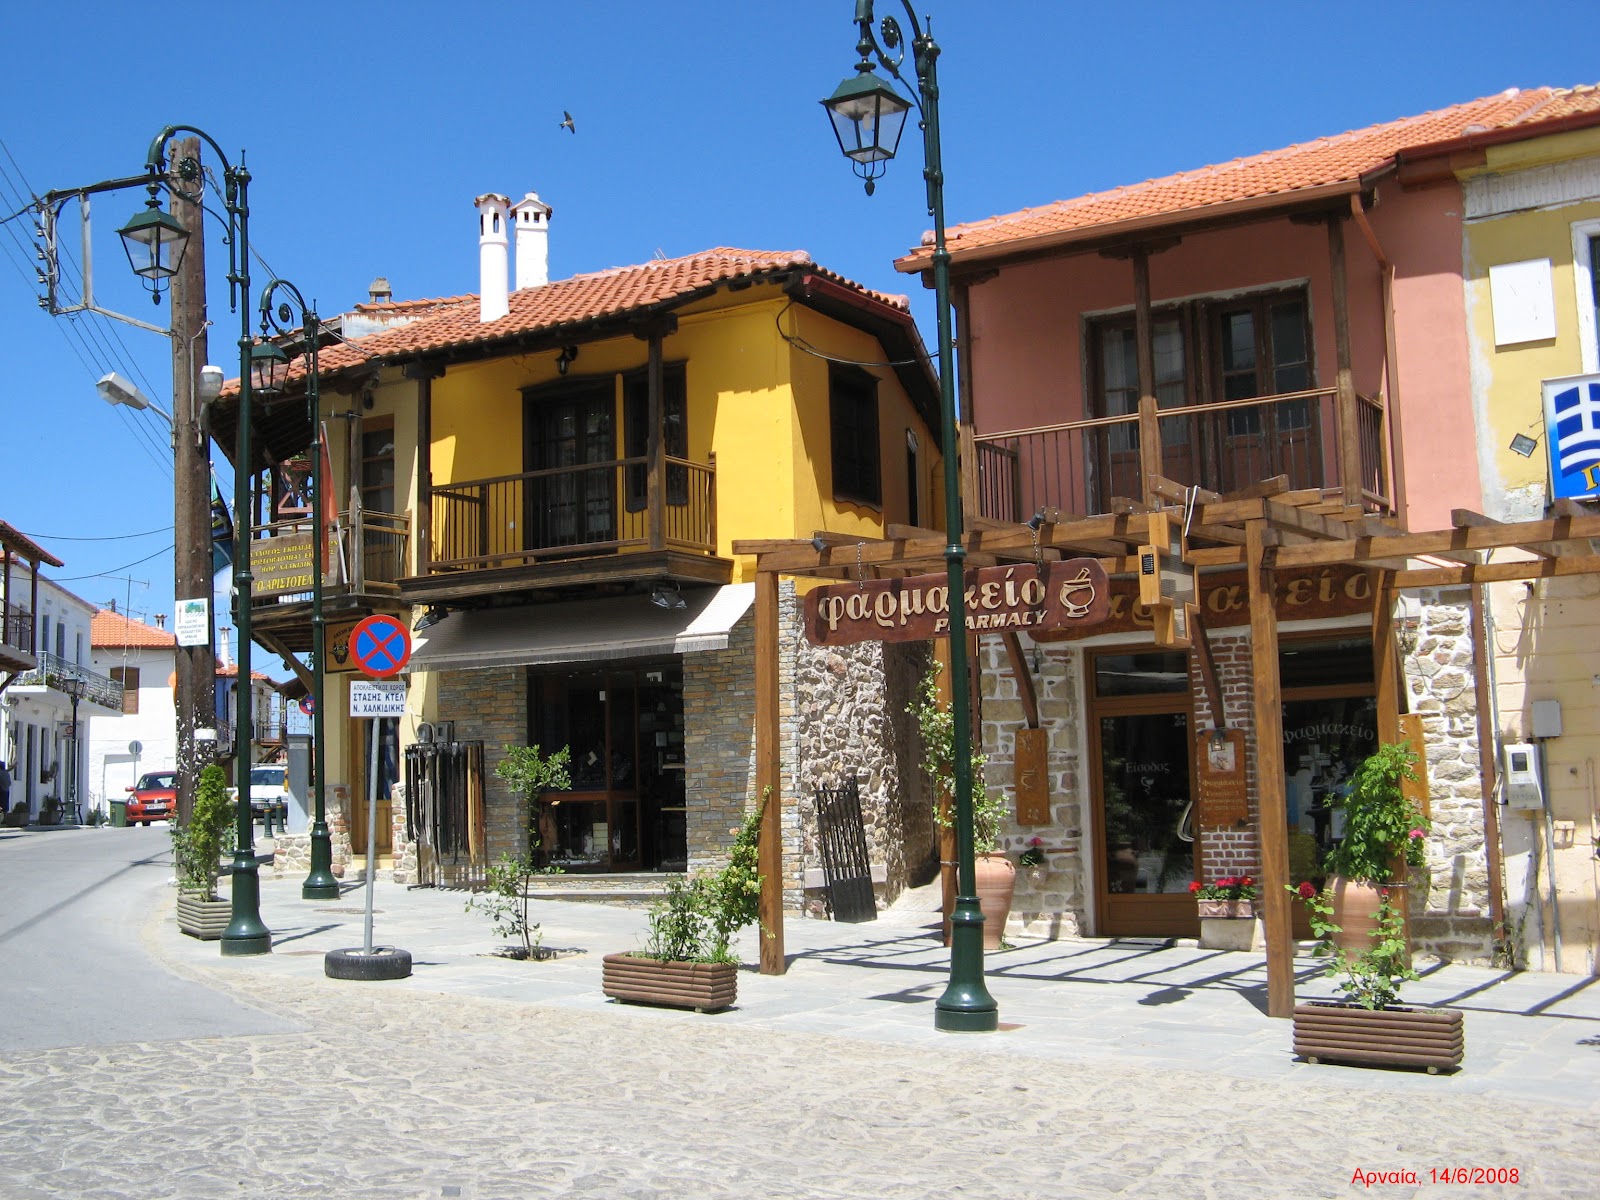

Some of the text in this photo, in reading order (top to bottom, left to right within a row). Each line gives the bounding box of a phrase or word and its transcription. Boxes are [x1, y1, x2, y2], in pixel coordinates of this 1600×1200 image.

[934, 609, 1048, 633] PARMACY
[353, 693, 404, 702] ΣΤΑΣΗΣ ΚΤΕΛ
[353, 703, 404, 713] Ν. ΧΑΛΚΙΔΙΚΗΣ
[1126, 761, 1170, 774] Είσοδος
